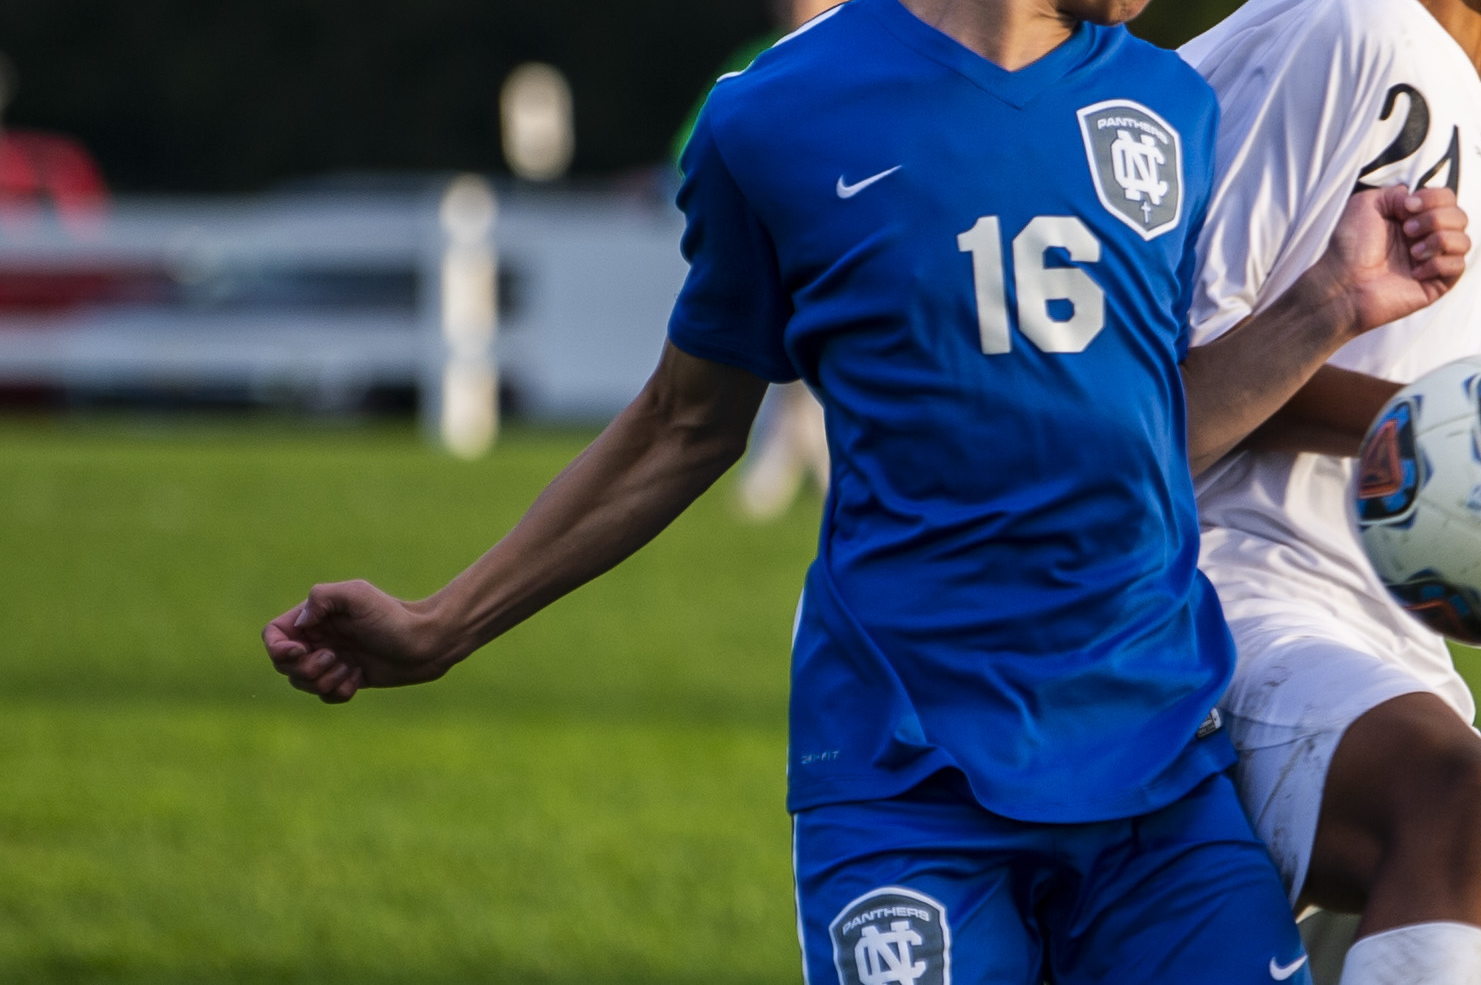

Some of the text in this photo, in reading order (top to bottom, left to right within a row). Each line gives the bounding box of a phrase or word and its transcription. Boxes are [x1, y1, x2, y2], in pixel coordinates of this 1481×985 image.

[1097, 117, 1169, 145] PANTHERS
[957, 215, 1105, 355] 16
[842, 907, 930, 935] PANTHERS
